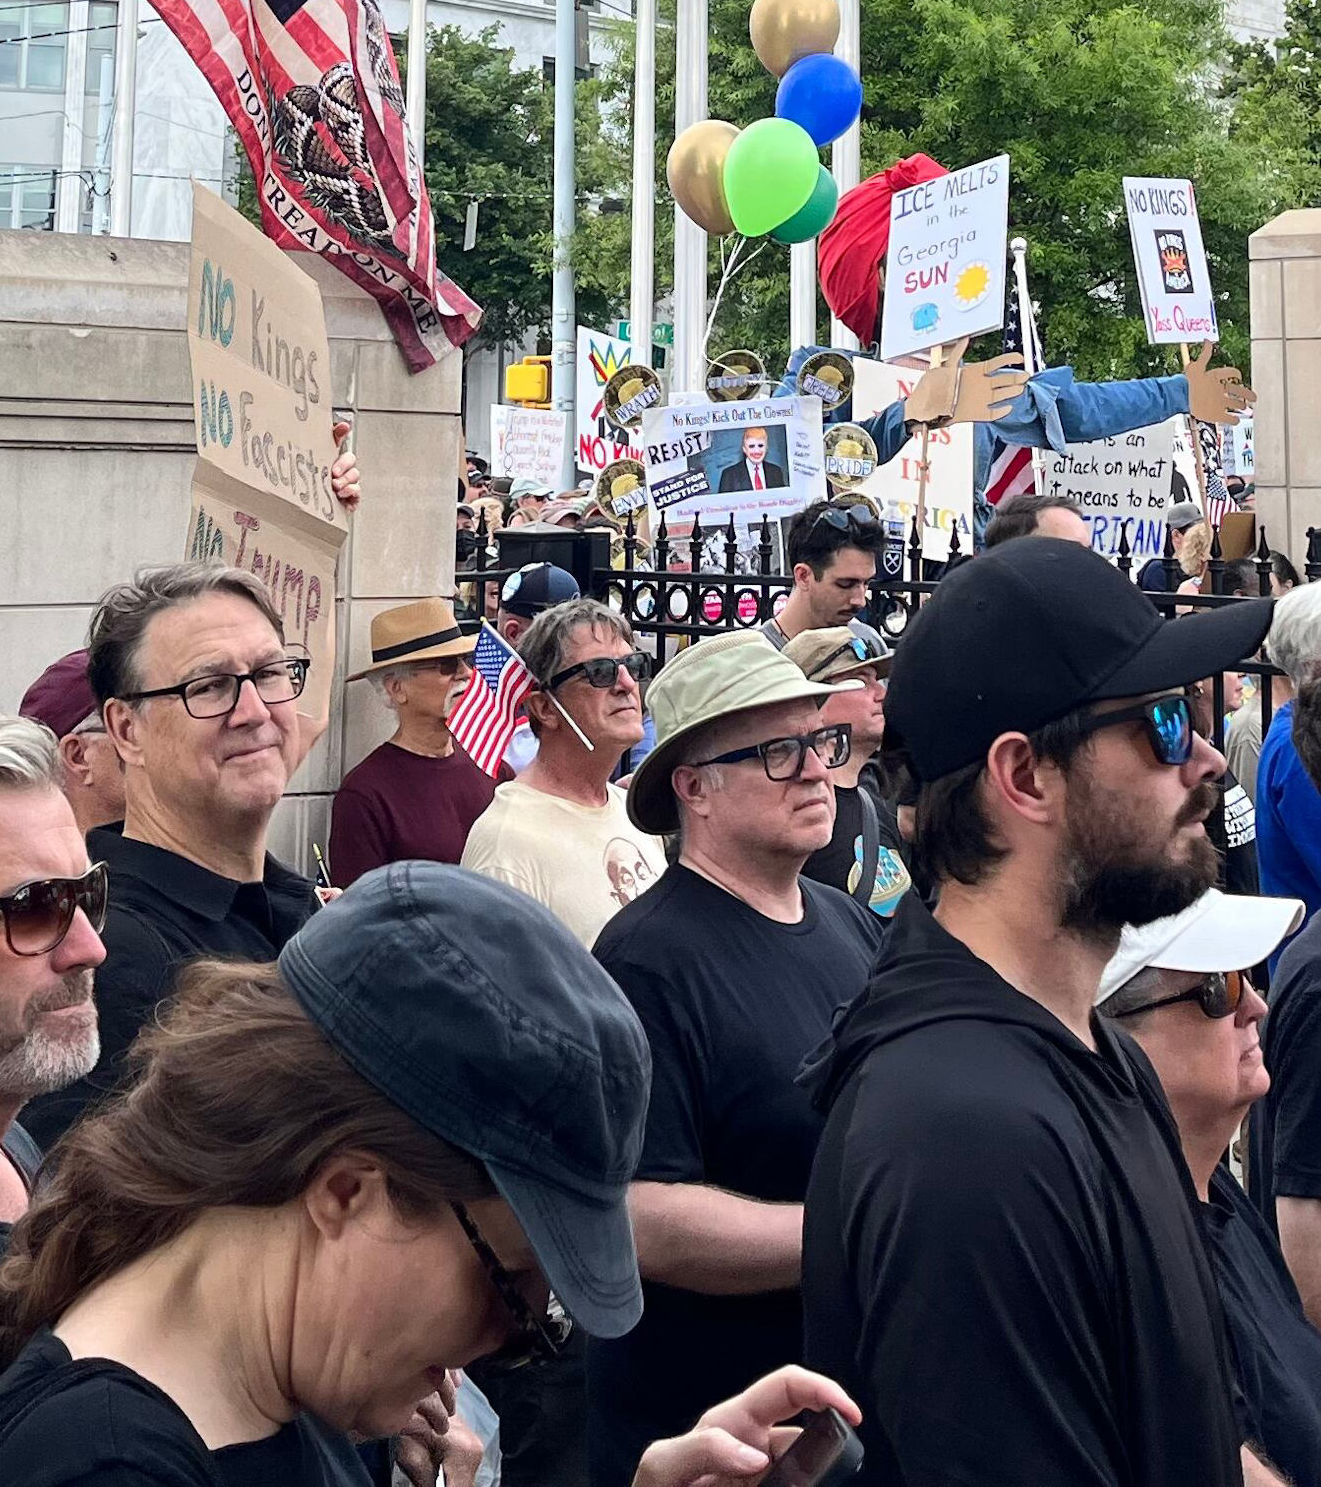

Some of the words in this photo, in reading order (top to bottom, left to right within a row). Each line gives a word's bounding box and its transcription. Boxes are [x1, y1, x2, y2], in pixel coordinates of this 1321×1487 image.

[894, 181, 936, 220] ICE
[944, 163, 999, 201] MELTS
[1129, 188, 1147, 212] NO
[927, 215, 939, 226] in
[950, 205, 969, 218] the
[264, 175, 342, 255] TREAD
[352, 252, 396, 285] ON
[401, 285, 438, 334] ME
[897, 230, 977, 266] Georgia
[904, 262, 949, 293] SUN
[198, 258, 235, 348] NO
[252, 289, 319, 421] Kings
[617, 386, 661, 421] WRATH
[672, 414, 684, 427] No
[732, 409, 746, 421] Out
[201, 378, 233, 448] NO
[240, 391, 334, 521] Fascists
[579, 432, 606, 468] NO
[1126, 434, 1145, 448] an
[827, 459, 873, 477] PRIDE
[1053, 456, 1099, 476] attack
[1104, 461, 1122, 475] on
[652, 480, 684, 498] STAND
[685, 473, 706, 486] FOR
[656, 481, 709, 507] JUSTICE
[1050, 480, 1062, 496] it
[1066, 489, 1118, 508] means
[1127, 488, 1142, 507] to
[1148, 488, 1165, 508] be
[613, 486, 648, 514] ENVY
